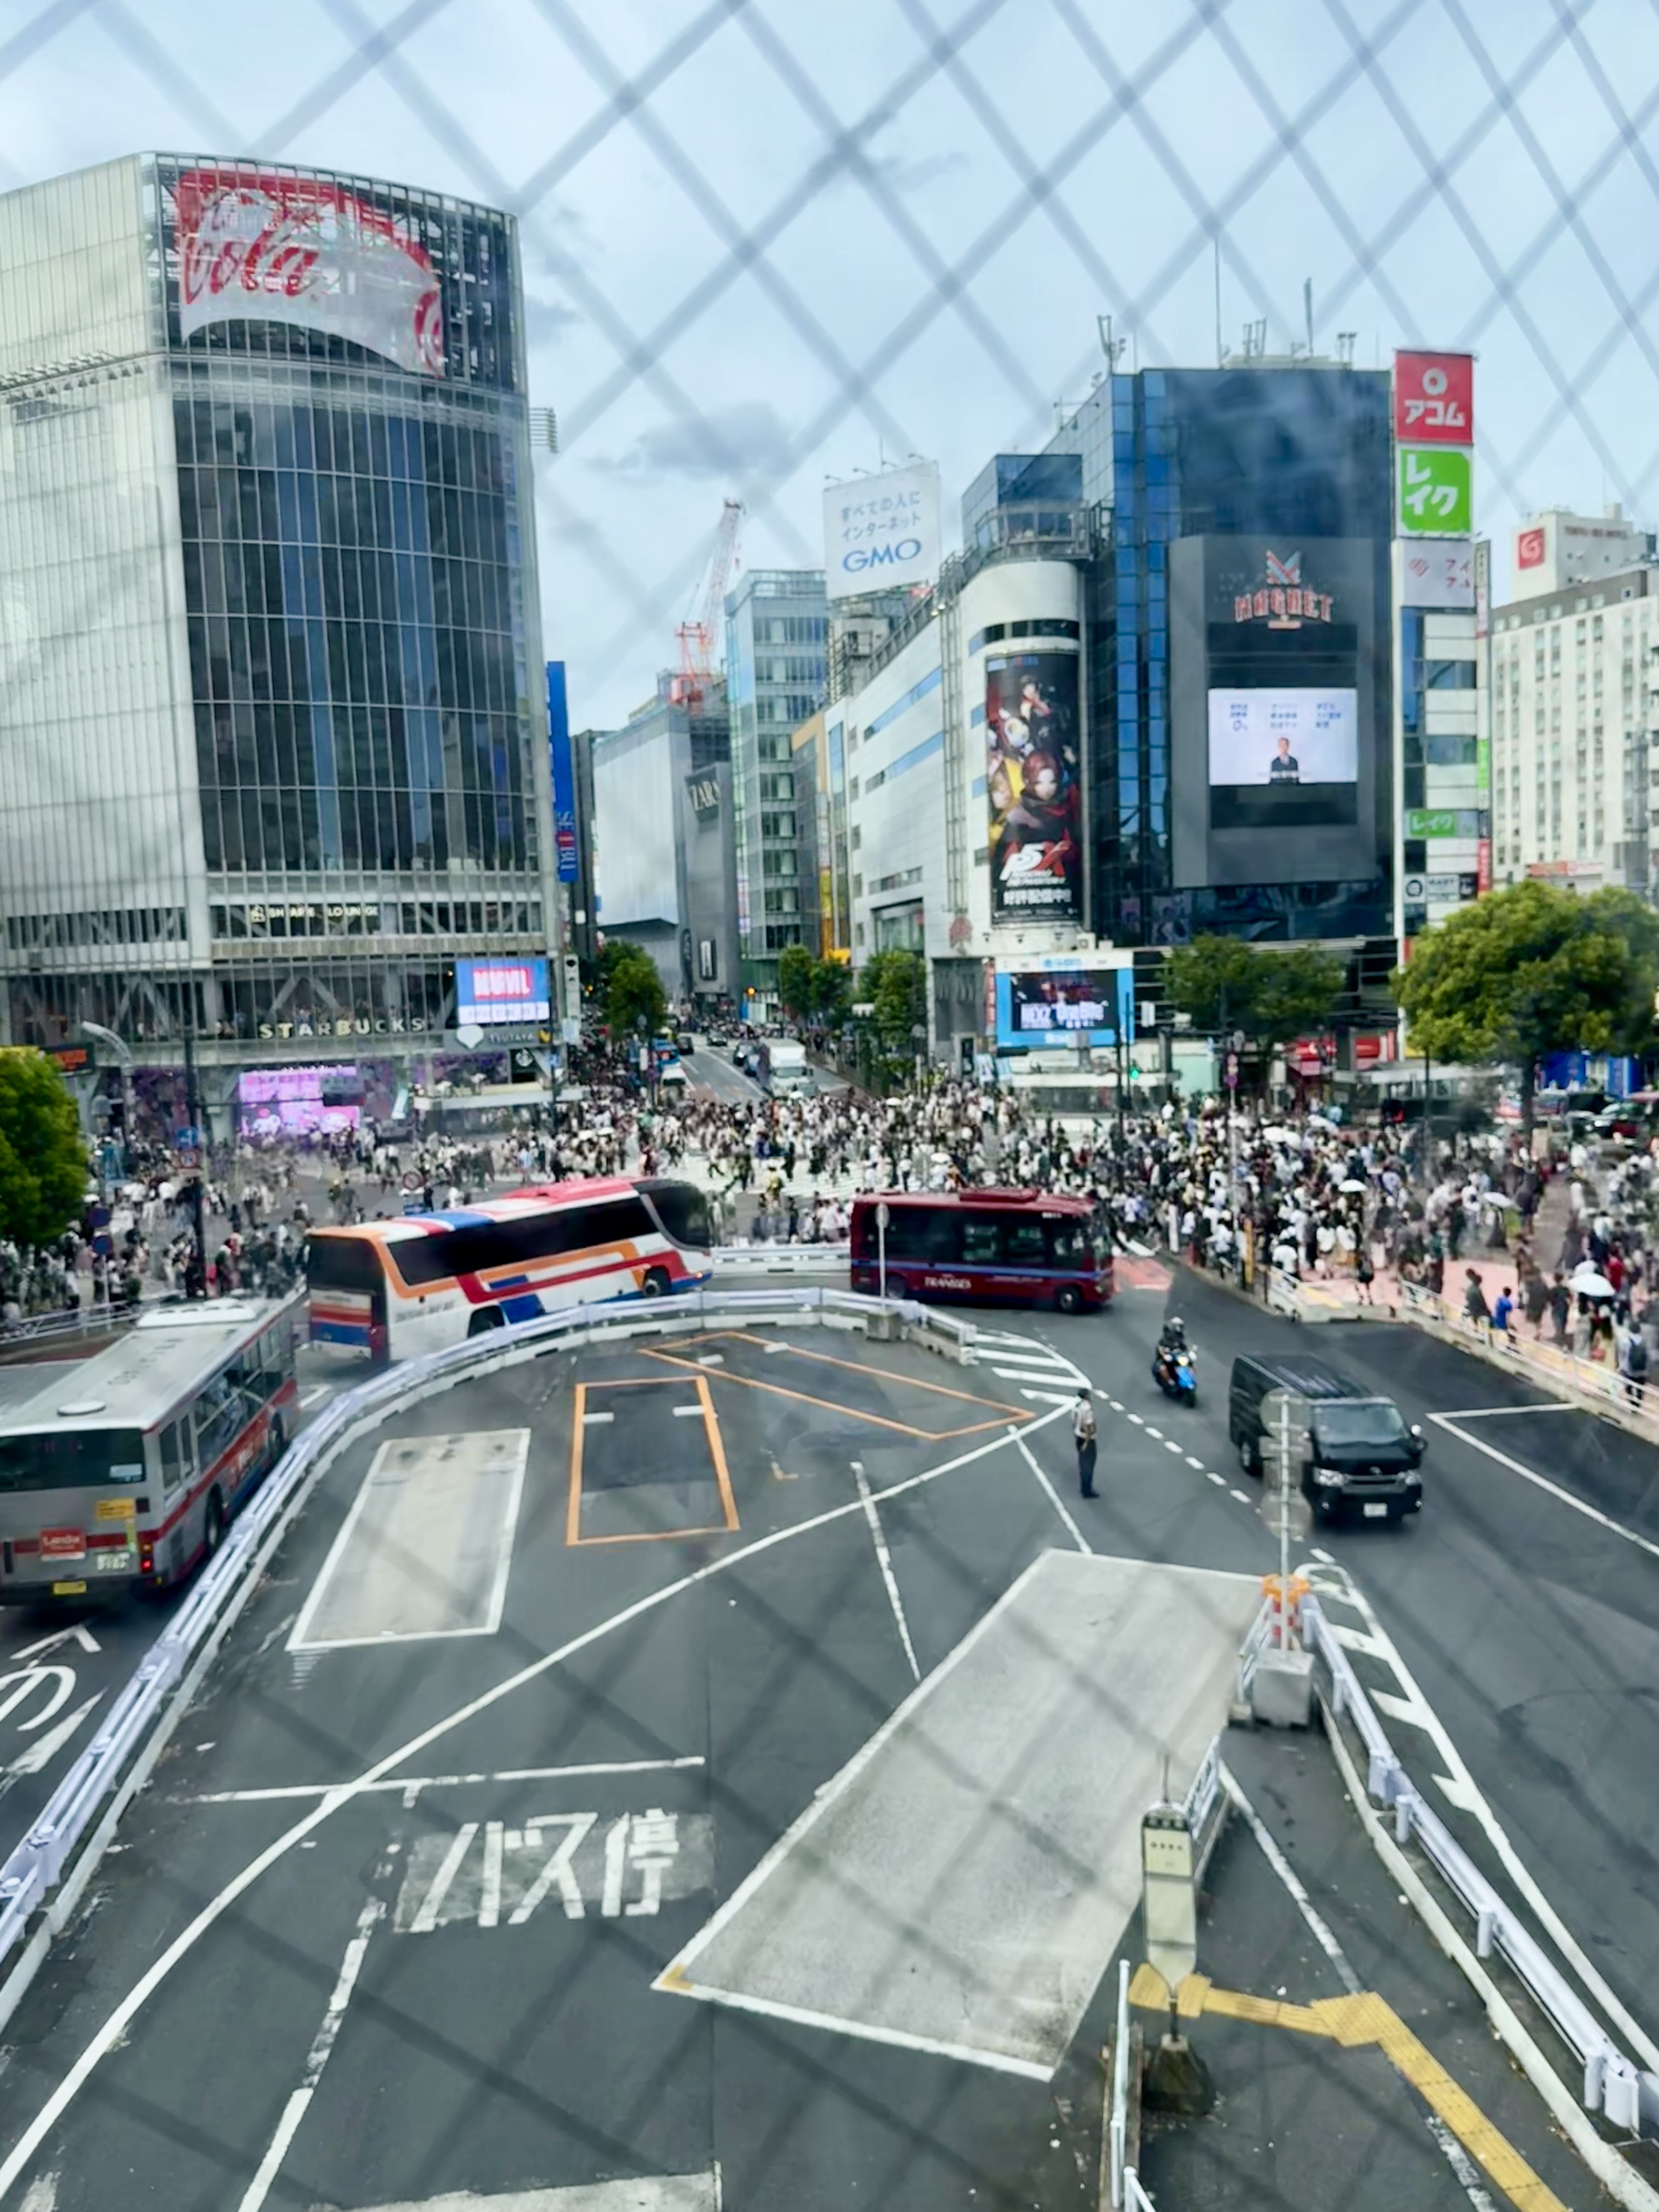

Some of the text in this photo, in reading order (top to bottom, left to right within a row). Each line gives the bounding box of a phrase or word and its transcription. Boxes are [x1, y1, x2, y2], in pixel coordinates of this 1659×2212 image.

[1404, 400, 1465, 427] アコム
[842, 538, 922, 572] GMO
[1234, 587, 1333, 623] MAGNET
[1412, 815, 1453, 830] レイク
[268, 906, 378, 918] SHARE LOUNGE
[259, 1017, 423, 1039] STARBUCKS
[409, 1808, 679, 1933] バス停
